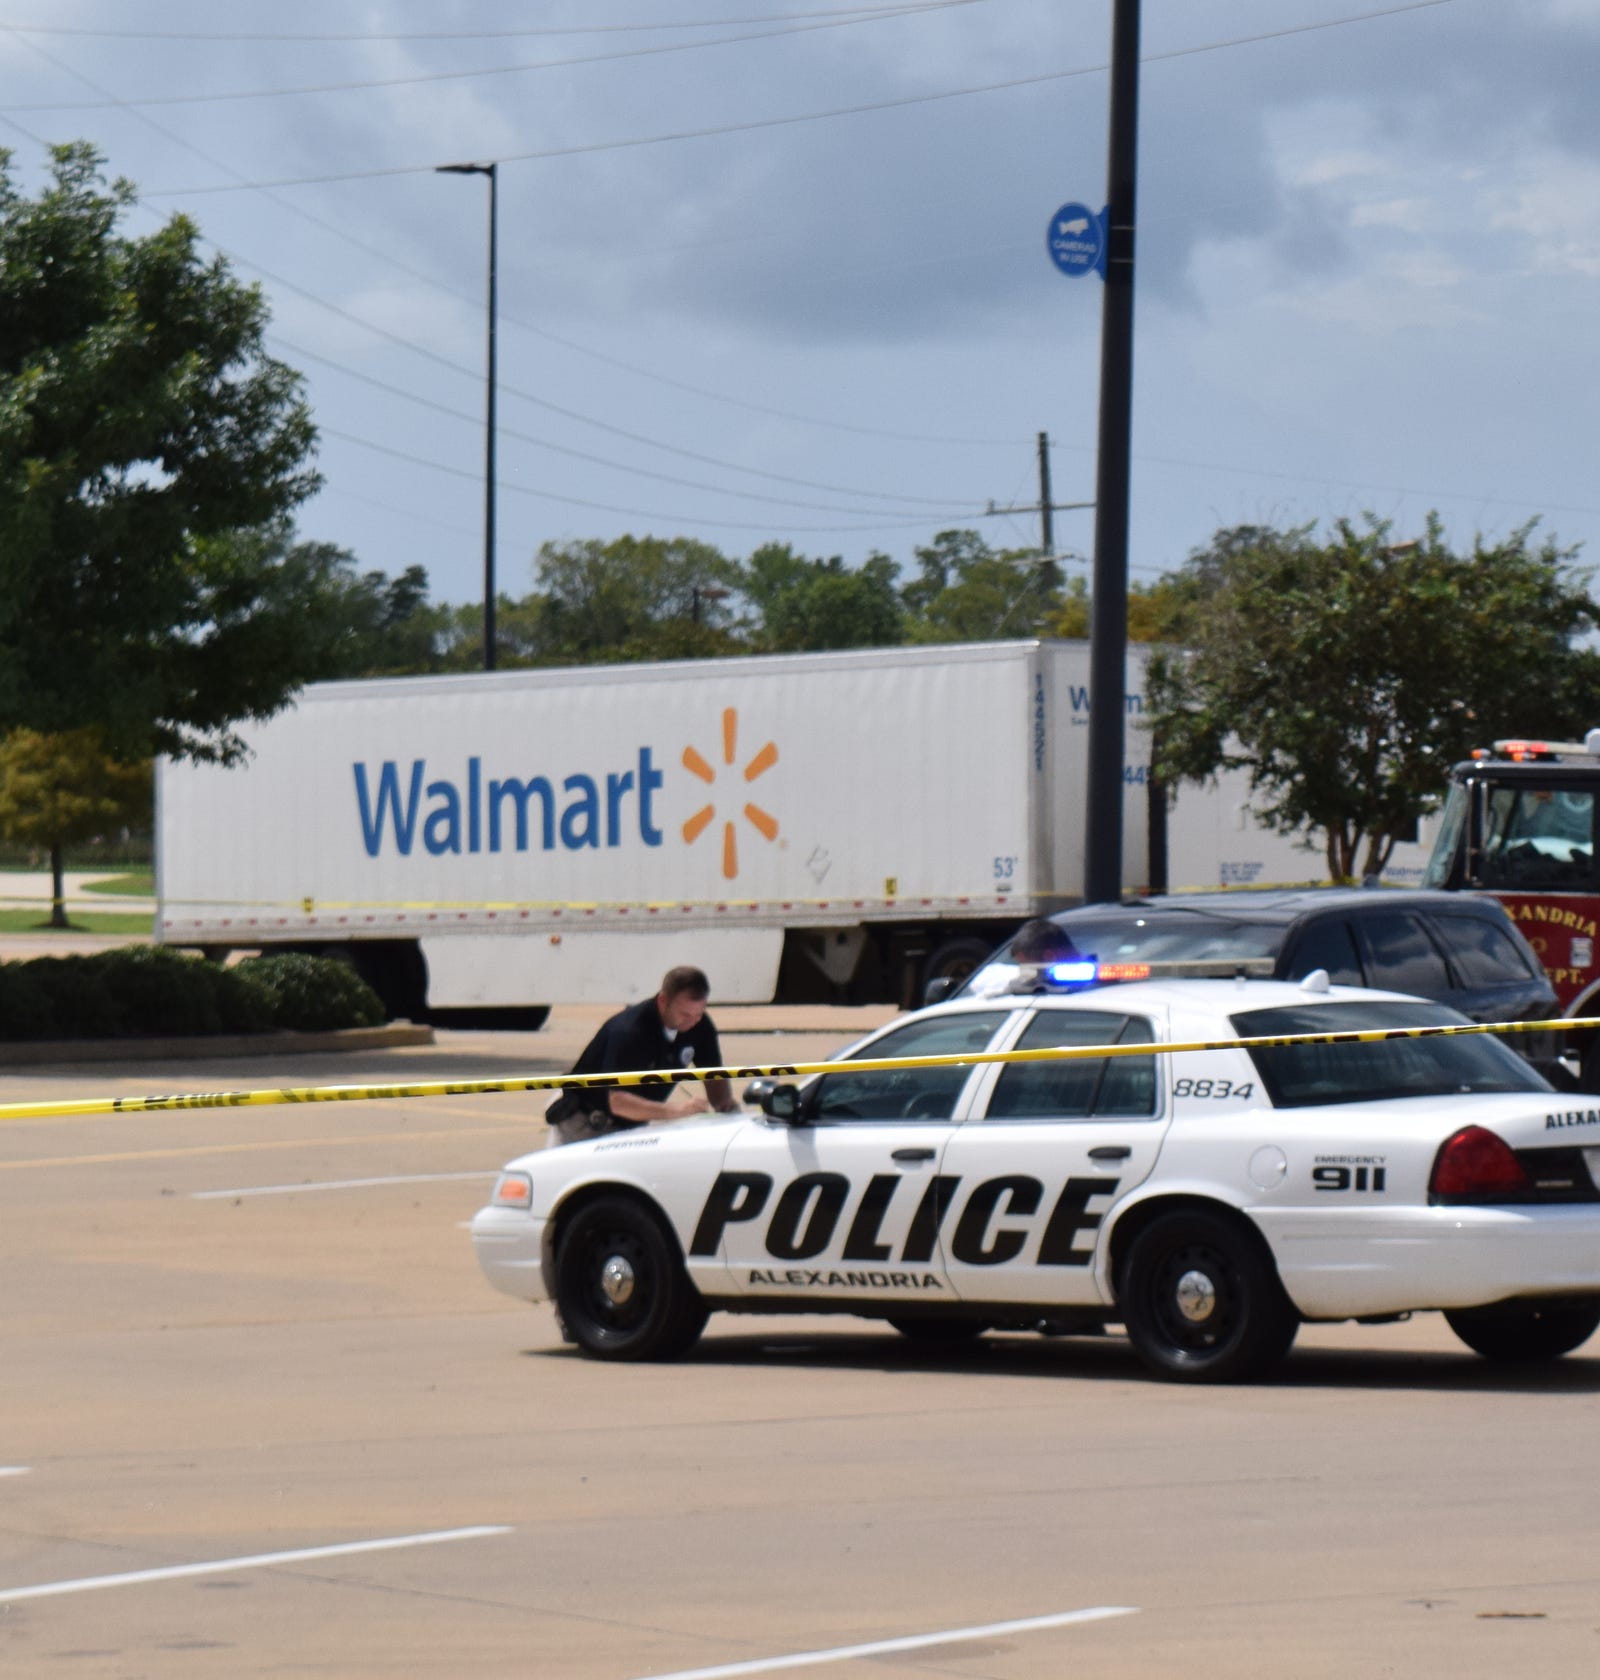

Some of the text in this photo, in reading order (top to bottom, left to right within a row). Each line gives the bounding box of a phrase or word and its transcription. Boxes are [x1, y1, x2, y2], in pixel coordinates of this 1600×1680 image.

[353, 747, 663, 857] Walmart
[1503, 904, 1597, 937] XANDRIA
[1173, 1078, 1254, 1100] 8834
[1314, 1155, 1387, 1164] EMERGENCY
[1312, 1166, 1387, 1191] 911
[688, 1171, 1121, 1266] POLICE
[748, 1269, 943, 1290] ALEXANDRIA
